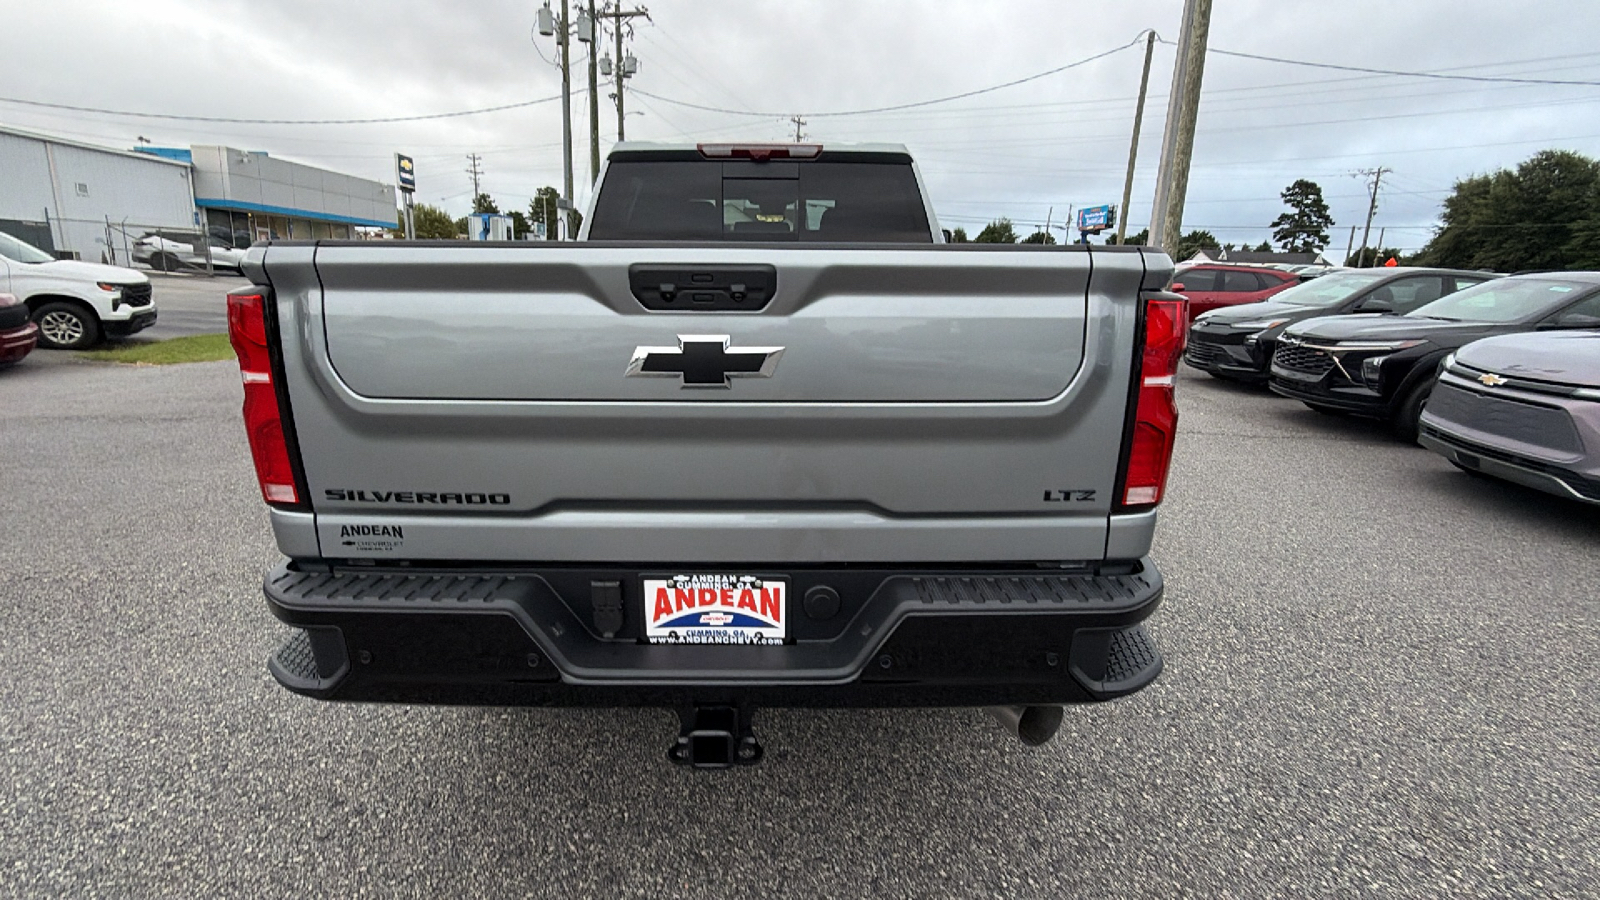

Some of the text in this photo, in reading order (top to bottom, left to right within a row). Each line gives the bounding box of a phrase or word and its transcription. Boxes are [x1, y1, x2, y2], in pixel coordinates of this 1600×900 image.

[325, 489, 511, 505] SILVERADO
[1043, 489, 1096, 502] LTZ
[341, 524, 403, 538] ANDEAN
[692, 575, 737, 583] ANDEAN
[737, 582, 753, 590] GA
[653, 587, 781, 624] ANDEAN
[649, 635, 784, 645] www.ANDEANCHEVY.com
